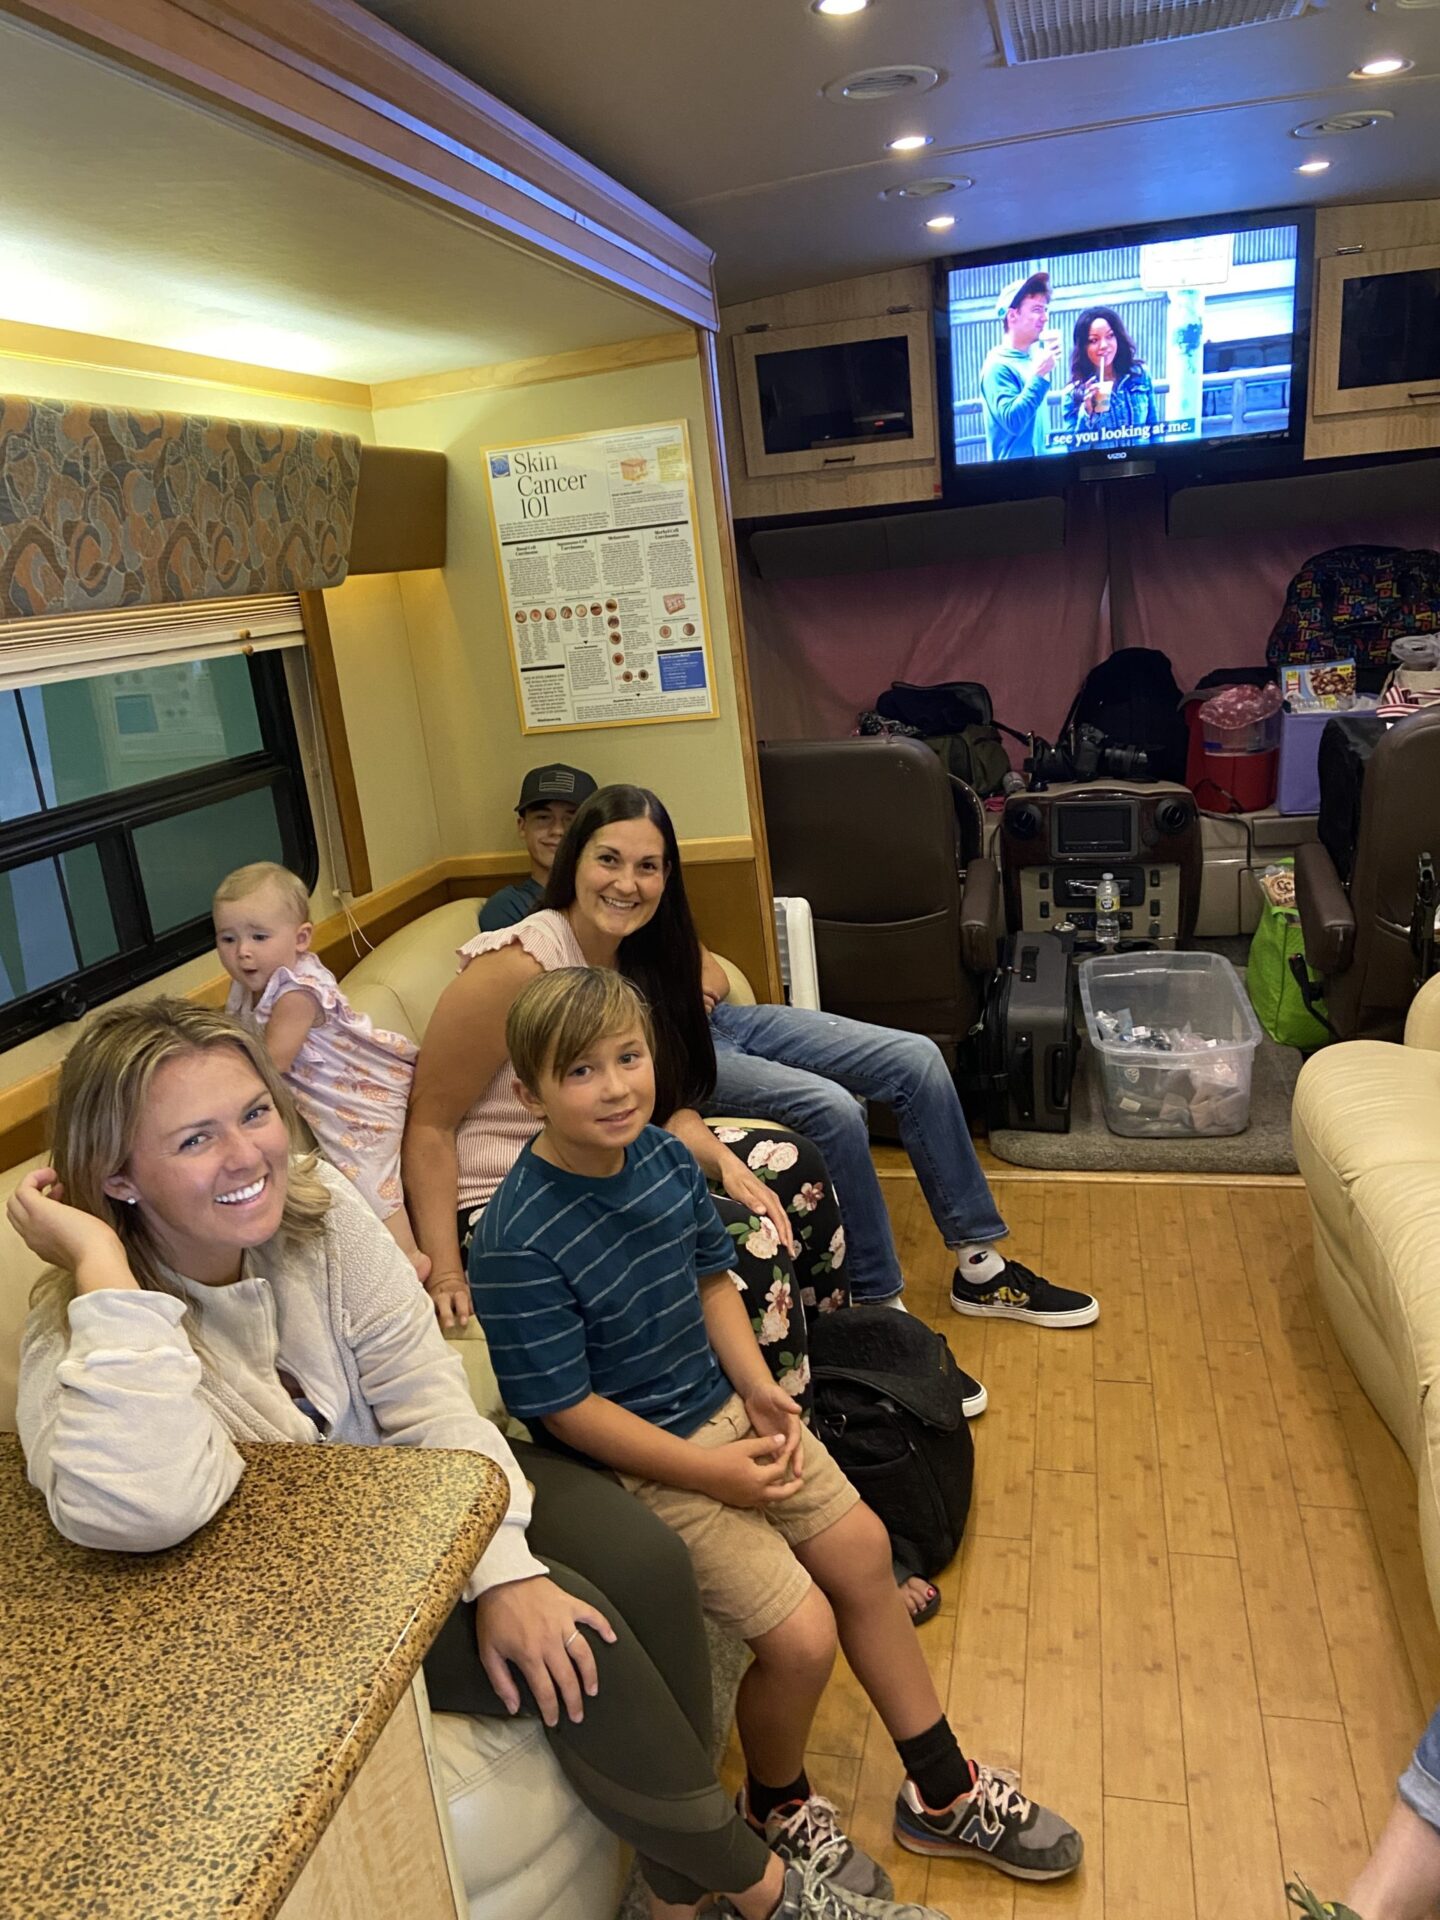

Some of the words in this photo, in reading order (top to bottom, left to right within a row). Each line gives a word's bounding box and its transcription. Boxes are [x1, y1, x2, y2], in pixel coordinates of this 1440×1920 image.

[1052, 435, 1073, 445] see
[1075, 432, 1099, 447] you
[1101, 425, 1151, 441] looking
[1152, 424, 1165, 435] at
[1167, 422, 1192, 433] me.
[514, 451, 558, 475] Skin
[517, 473, 588, 497] Cancer
[520, 495, 549, 519] 101
